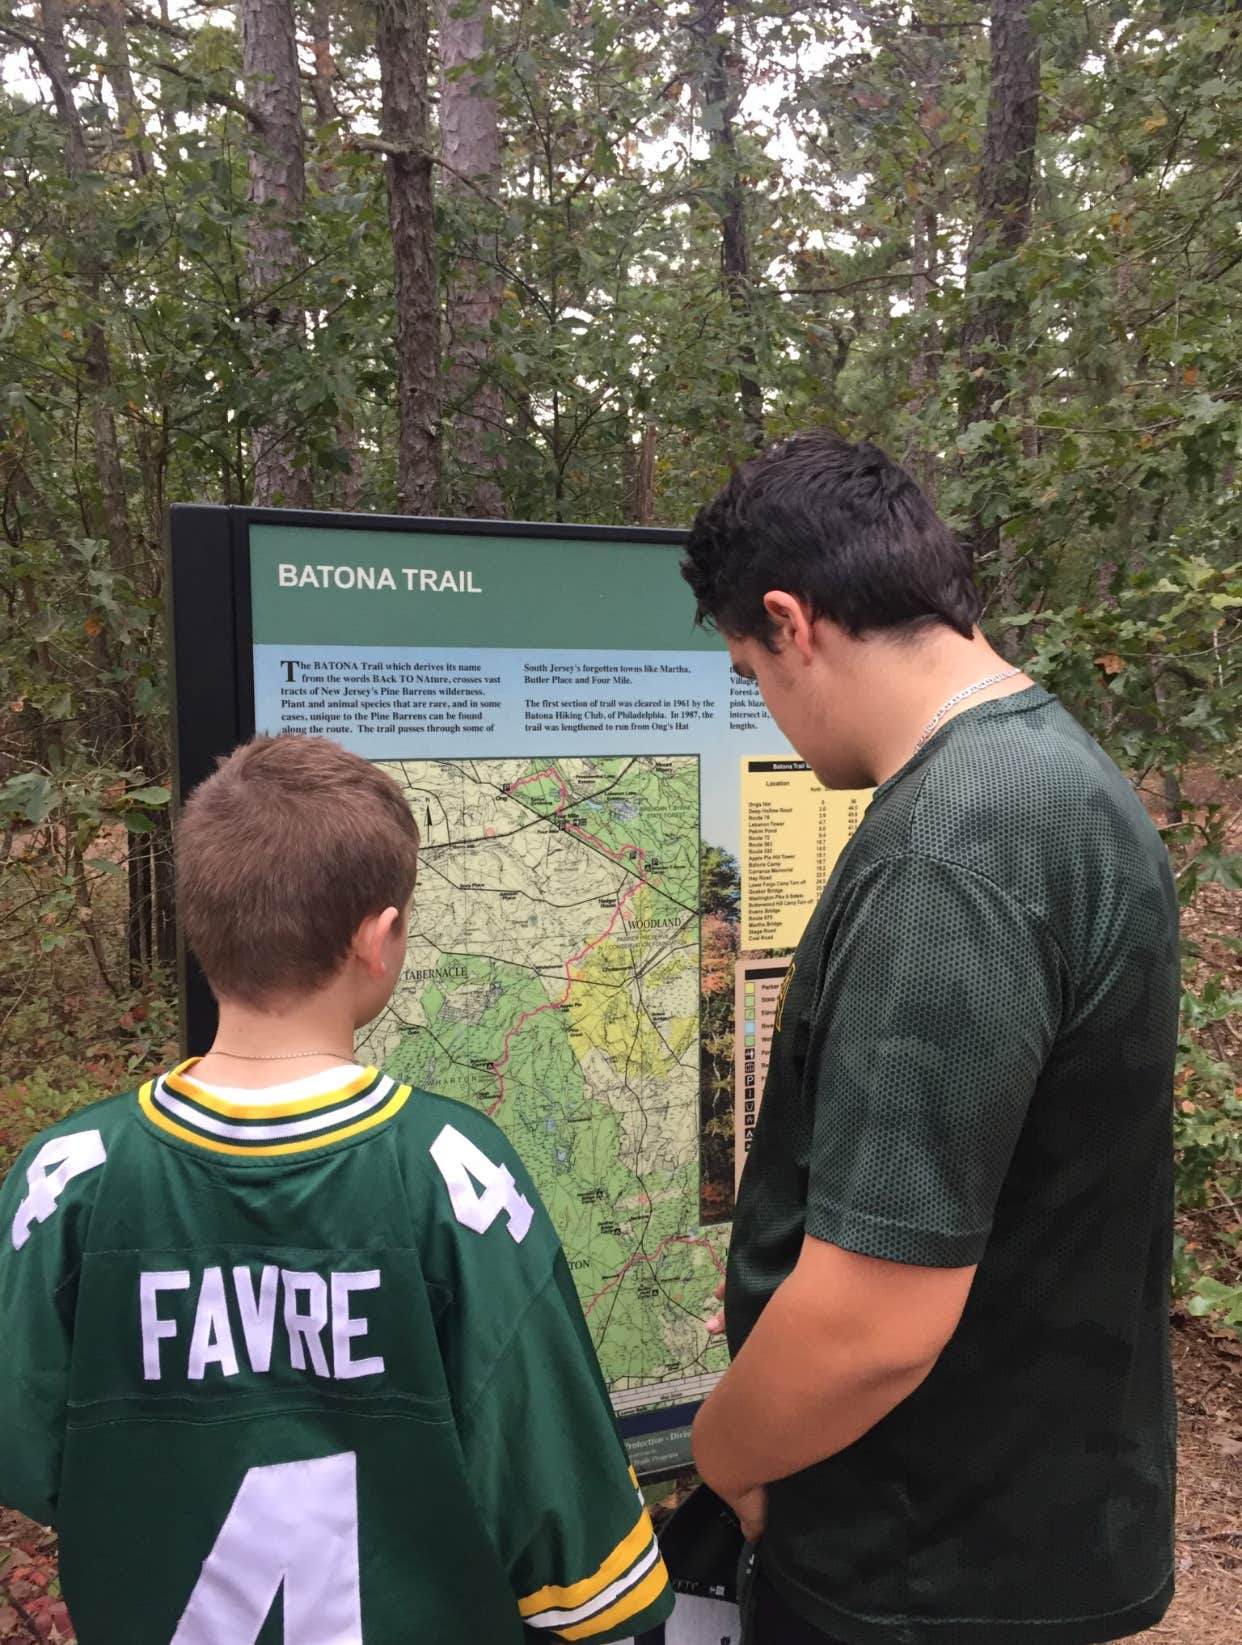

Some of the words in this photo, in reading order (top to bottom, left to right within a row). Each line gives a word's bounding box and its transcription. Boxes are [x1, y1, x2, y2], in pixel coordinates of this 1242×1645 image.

[278, 563, 396, 590] BATONA
[402, 568, 482, 593] TRAIL
[280, 660, 311, 683] The
[314, 661, 359, 670] BATONA
[361, 662, 383, 670] Trail
[386, 662, 411, 671] which
[413, 663, 444, 671] derives
[446, 663, 456, 671] its
[524, 664, 548, 672] South
[550, 664, 581, 674] Jersey's
[583, 664, 618, 673] forgotten
[620, 664, 643, 672] towns
[644, 664, 658, 672] like
[302, 674, 324, 683] from
[327, 674, 340, 683] the
[343, 674, 370, 683] words
[373, 675, 397, 684] BAck
[400, 675, 414, 684] TO
[417, 675, 452, 684] NAture,
[453, 675, 482, 684] crosses
[484, 675, 501, 684] vast
[524, 676, 550, 684] Butler
[552, 676, 572, 684] Place
[575, 676, 589, 684] and
[592, 676, 611, 684] Four
[613, 676, 632, 684] Mile.
[281, 687, 307, 696] tracts
[309, 687, 319, 696] of
[321, 687, 340, 696] New
[343, 687, 378, 698] Jersey's
[381, 687, 399, 696] Pine
[402, 687, 437, 696] Barrens
[439, 687, 485, 696] wilderness.
[281, 700, 305, 708] Plant
[308, 700, 325, 708] and
[327, 700, 358, 708] animal
[360, 700, 391, 710] species
[393, 700, 411, 708] that
[413, 700, 427, 708] are
[429, 700, 450, 708] rare,
[452, 700, 468, 708] and
[470, 700, 478, 708] in
[480, 700, 501, 708] some
[525, 700, 540, 708] The
[542, 700, 558, 708] first
[561, 700, 588, 708] section
[589, 700, 597, 708] of
[599, 700, 616, 708] trail
[618, 700, 632, 708] was
[634, 700, 662, 708] cleared
[663, 700, 671, 708] in
[673, 700, 690, 708] 1961
[692, 700, 701, 708] by
[703, 700, 715, 708] the
[730, 700, 745, 709] pink
[281, 712, 308, 721] cases,
[310, 712, 340, 722] unique
[343, 712, 352, 720] to
[354, 712, 368, 720] the
[370, 712, 390, 720] Pine
[392, 712, 427, 720] Barrens
[429, 712, 444, 720] can
[446, 712, 456, 720] be
[458, 712, 482, 720] found
[555, 711, 582, 720] Hiking
[607, 711, 615, 719] of
[617, 711, 667, 720] Philadelphia.
[670, 711, 679, 719] In
[681, 711, 701, 719] 1987,
[702, 711, 713, 719] the
[281, 725, 307, 735] along
[309, 725, 324, 733] the
[326, 725, 353, 733] route.
[358, 725, 374, 733] The
[376, 725, 395, 733] trail
[397, 725, 424, 734] passes
[426, 724, 460, 734] through
[486, 724, 495, 733] of
[525, 723, 542, 731] trail
[561, 723, 603, 732] lengthened
[605, 723, 613, 731] to
[651, 723, 673, 731] Ong's
[730, 722, 758, 731] lengths.
[628, 917, 682, 929] WOODLAND
[403, 966, 468, 981] TABERNACLE
[427, 1076, 477, 1086] WHARTON
[429, 1124, 535, 1244] 4
[11, 1129, 107, 1252] 4
[139, 1265, 385, 1382] FAVRE
[168, 1451, 362, 1645] 4
